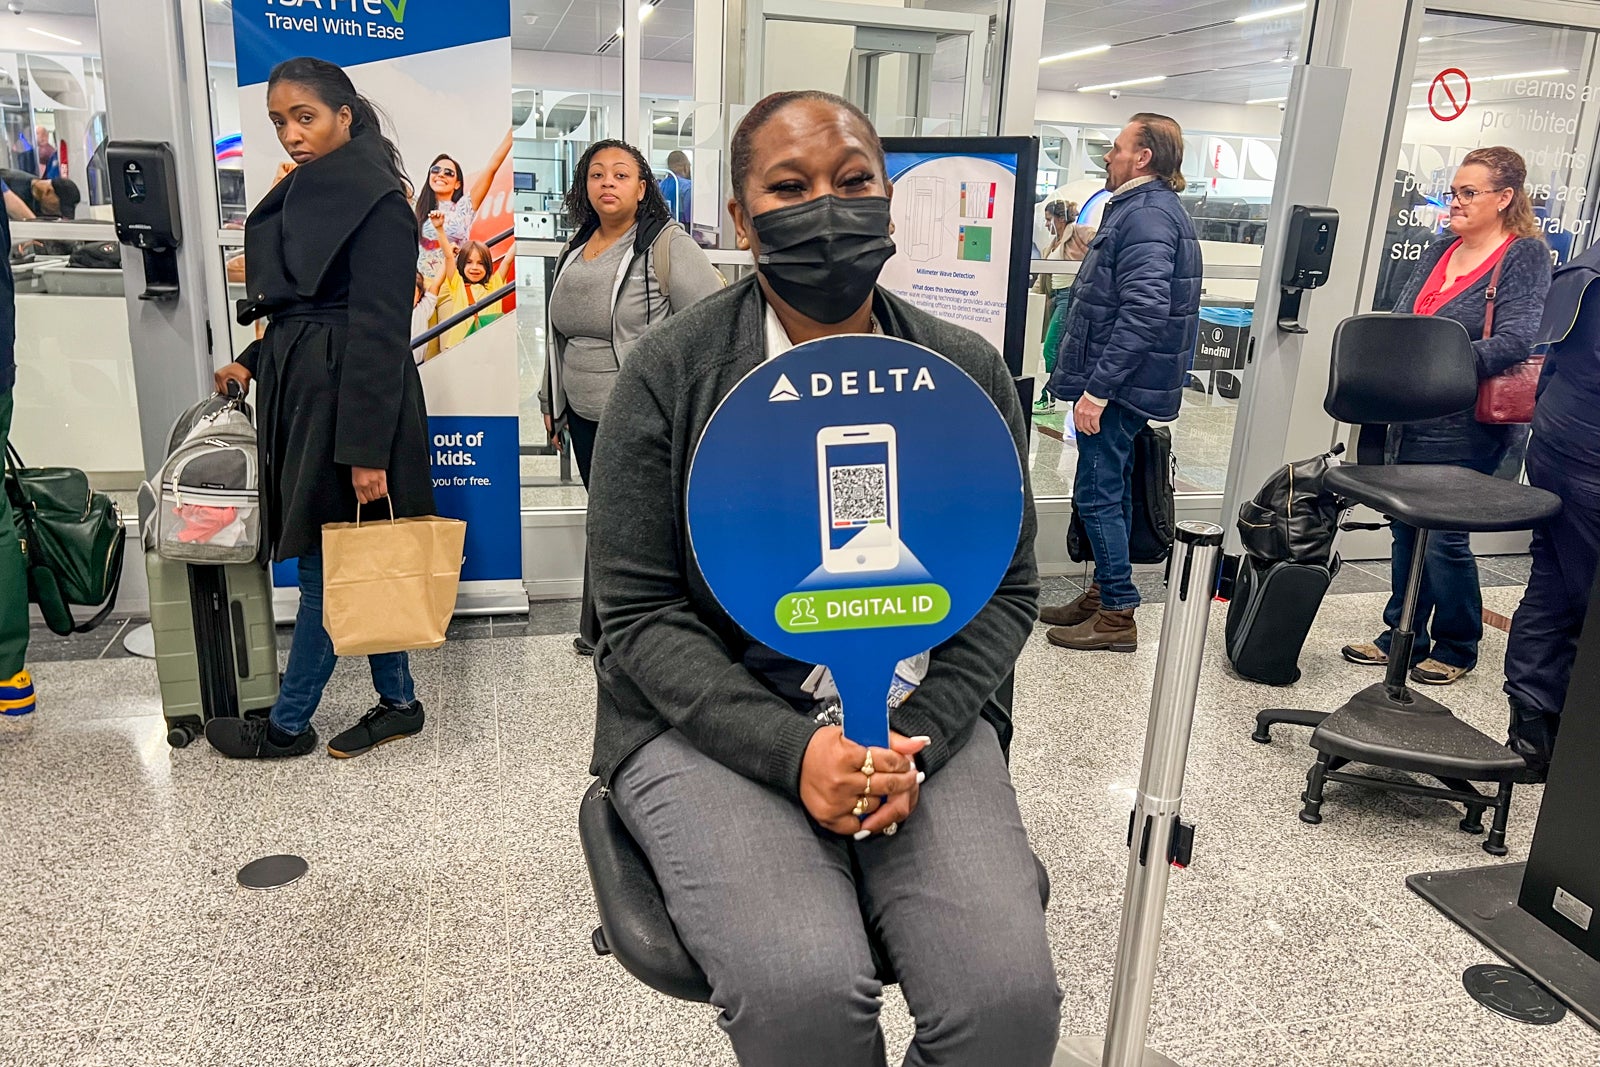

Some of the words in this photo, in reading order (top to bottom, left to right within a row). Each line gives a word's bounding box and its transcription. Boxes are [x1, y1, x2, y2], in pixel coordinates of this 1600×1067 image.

[264, 12, 318, 33] Travel
[322, 17, 362, 36] With
[366, 22, 405, 40] Ease
[1502, 78, 1577, 101] irearms
[1480, 107, 1579, 135] prohibited
[1555, 184, 1587, 202] are
[1396, 209, 1452, 233] suje
[1532, 213, 1567, 235] eral
[1570, 219, 1591, 236] or
[1390, 239, 1430, 261] stat
[953, 271, 976, 280] Detection
[911, 283, 924, 291] What
[944, 287, 969, 297] technology
[969, 289, 979, 297] do?
[1200, 343, 1231, 359] landfill
[810, 367, 936, 397] DELTA
[433, 432, 463, 447] out
[465, 431, 484, 447] of
[436, 450, 476, 466] kids.
[432, 478, 451, 488] you
[453, 476, 468, 486] for
[469, 476, 492, 486] free.
[826, 597, 907, 619] DIGITAL
[912, 595, 934, 613] ID
